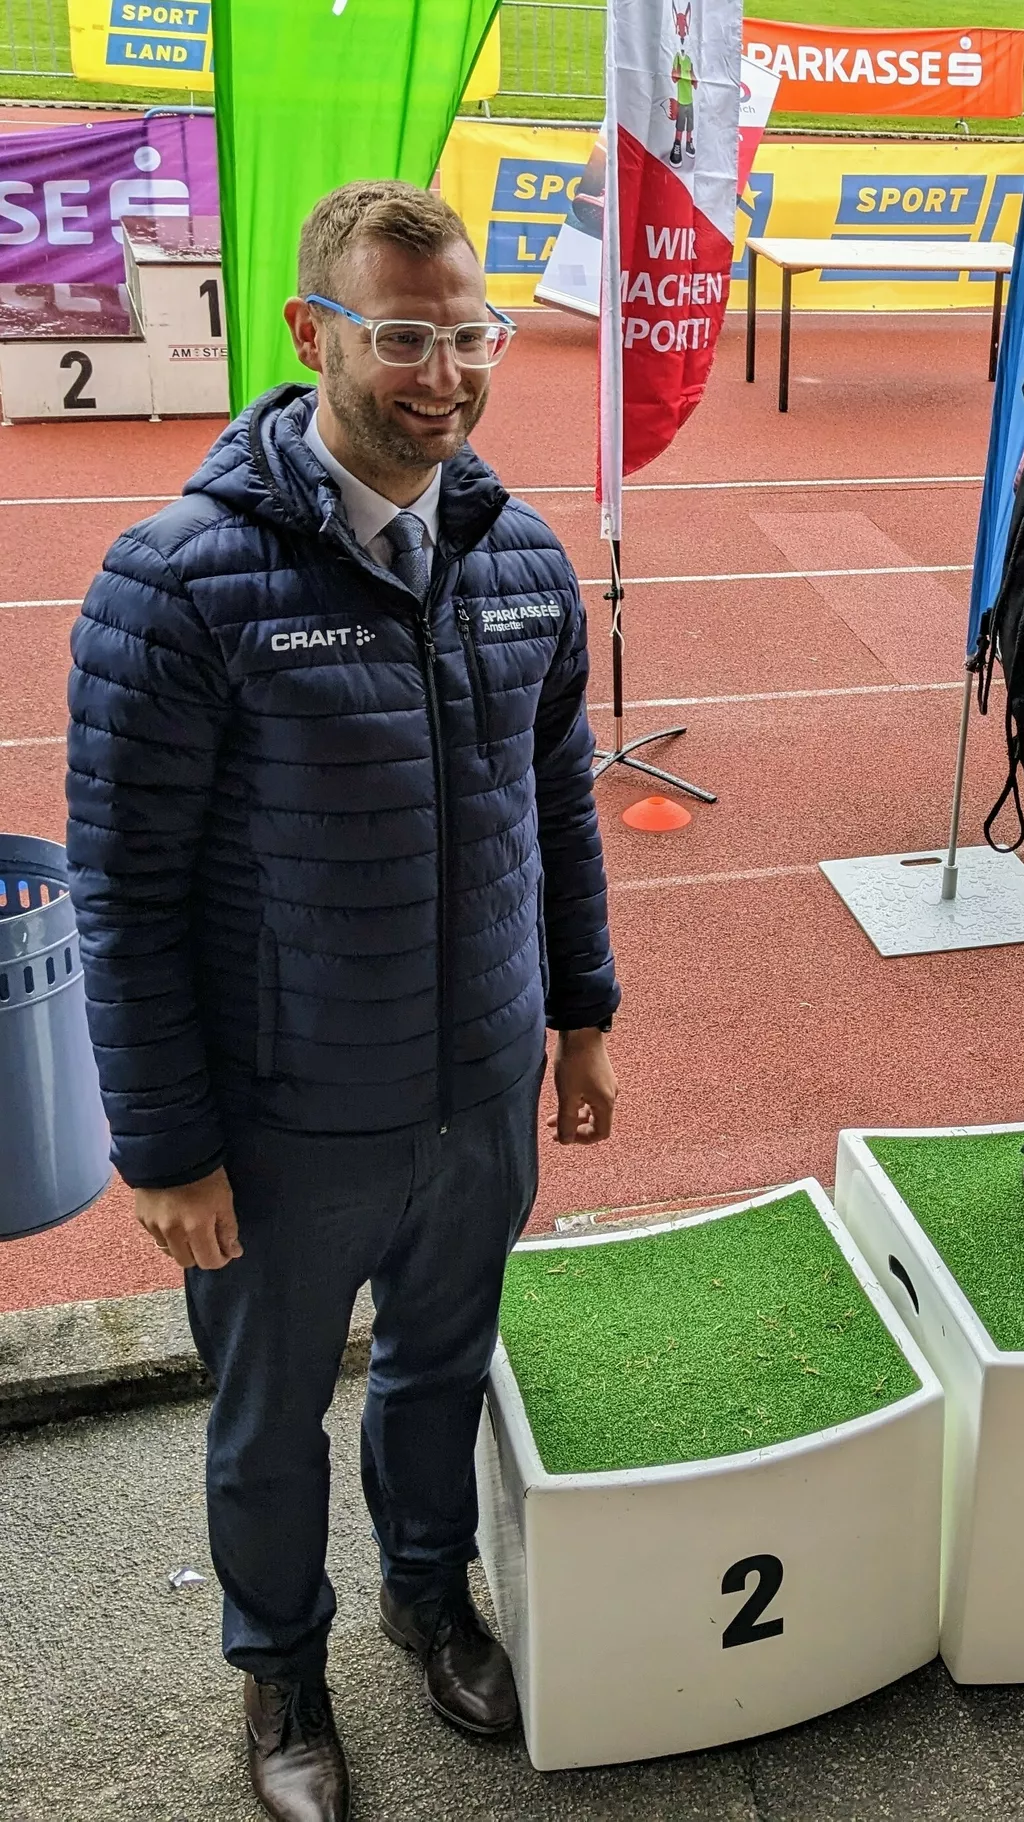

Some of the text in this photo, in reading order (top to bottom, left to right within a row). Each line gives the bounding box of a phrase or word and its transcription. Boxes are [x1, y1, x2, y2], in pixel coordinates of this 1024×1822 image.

[122, 5, 199, 26] SPORT
[125, 42, 188, 63] LAND
[743, 42, 941, 86] PARKASSE
[0, 179, 95, 246] SE
[856, 187, 969, 213] SPORT
[645, 225, 698, 261] WIR
[199, 279, 222, 337] 1
[620, 317, 711, 353] PORT!
[59, 350, 97, 409] 2
[481, 604, 549, 622] SPARKASSE
[271, 628, 350, 651] CRAFT
[720, 1553, 785, 1650] 2
